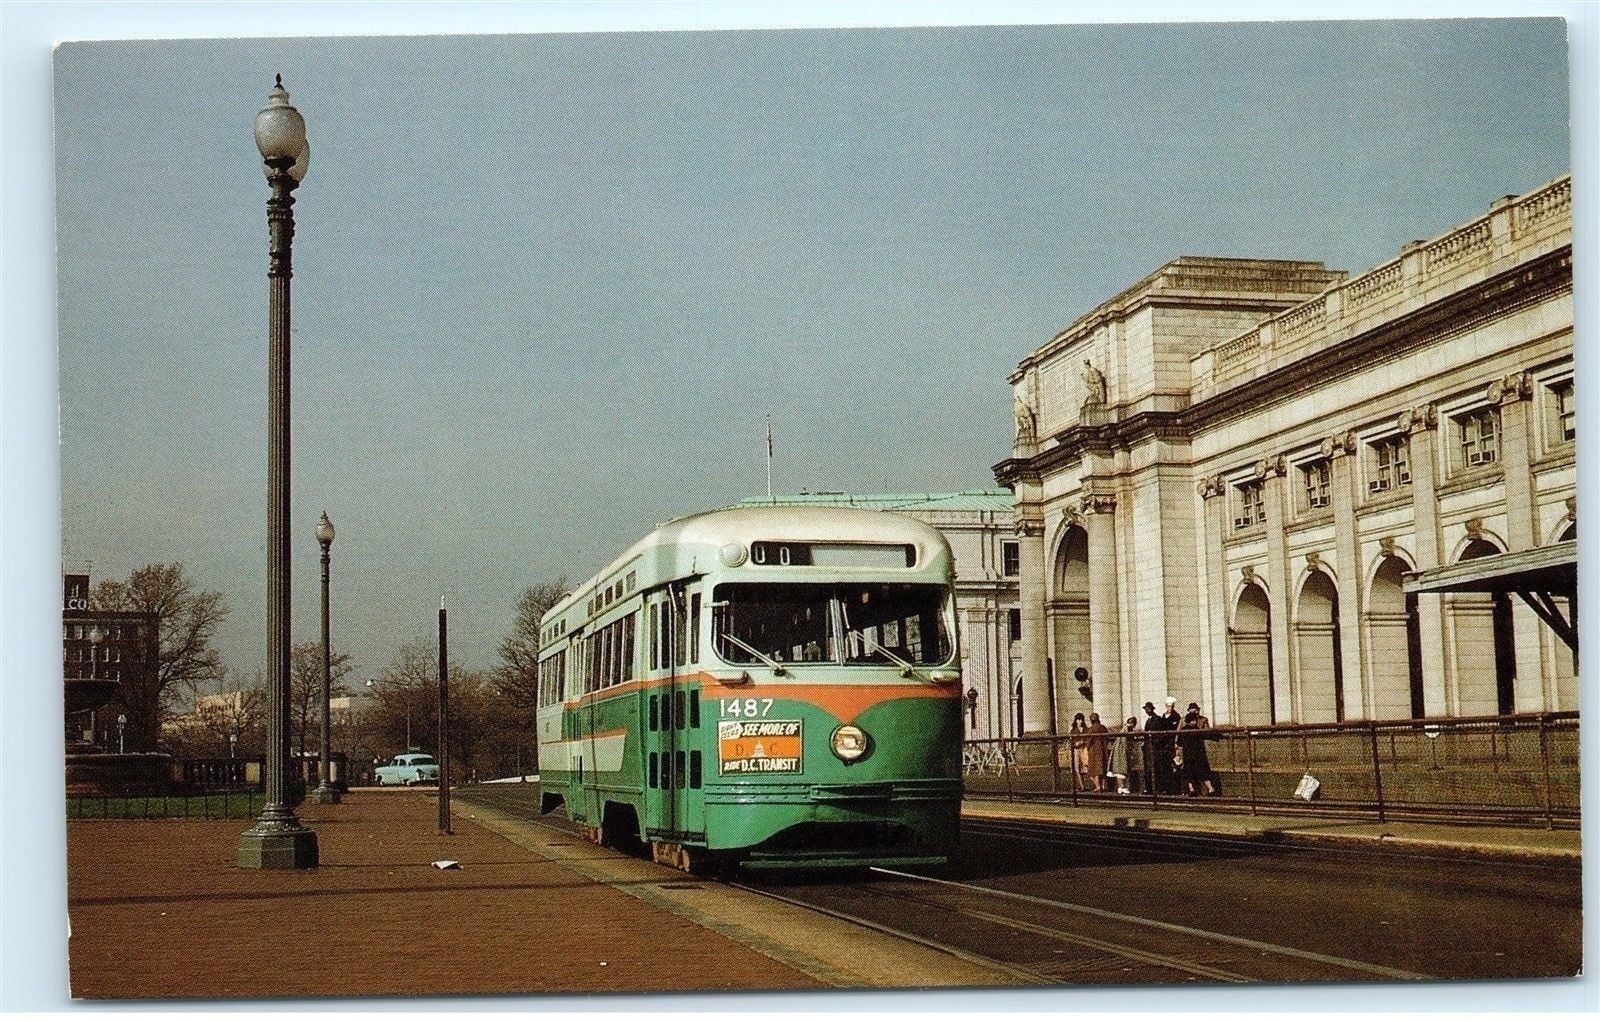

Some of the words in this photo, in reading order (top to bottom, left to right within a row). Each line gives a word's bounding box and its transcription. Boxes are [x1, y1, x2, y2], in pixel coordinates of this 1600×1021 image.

[720, 699, 773, 718] 1487
[743, 724, 760, 736] SEE
[759, 723, 785, 736] MORE
[785, 723, 798, 735] OF
[758, 759, 797, 770] TRANSIT
